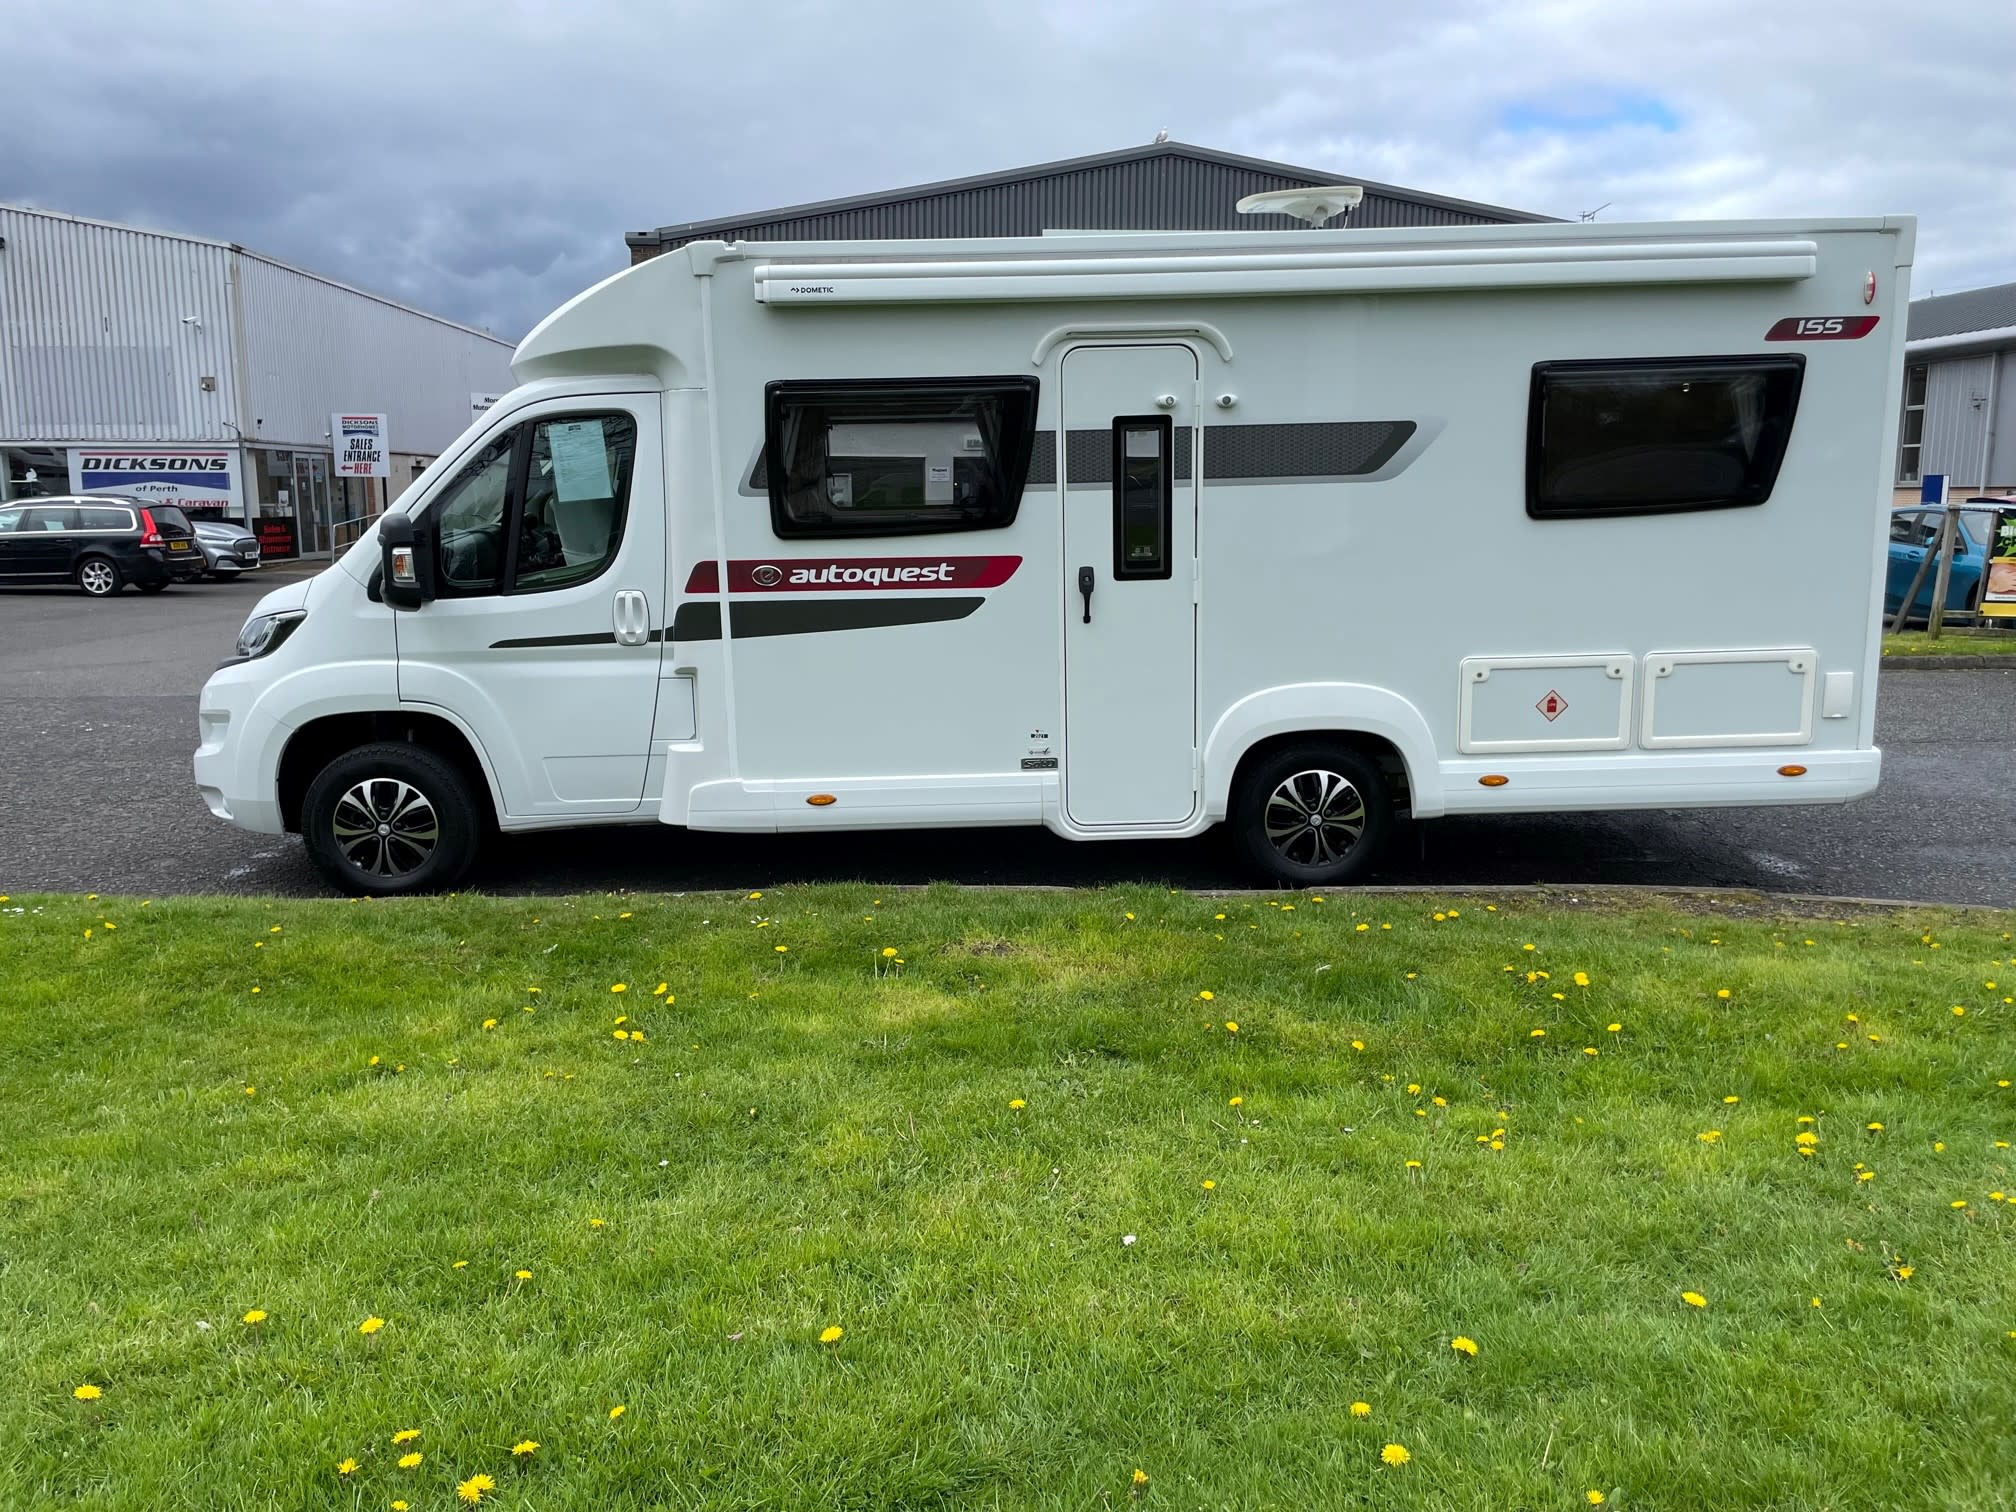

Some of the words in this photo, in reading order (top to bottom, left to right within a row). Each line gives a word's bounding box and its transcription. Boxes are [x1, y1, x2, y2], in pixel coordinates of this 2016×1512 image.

[350, 438, 373, 450] SALES
[343, 450, 382, 463] ENTRANCE
[82, 457, 228, 471] DICKSONS
[353, 462, 372, 475] HERE
[178, 498, 229, 507] Caravan
[788, 562, 955, 586] autoquest
